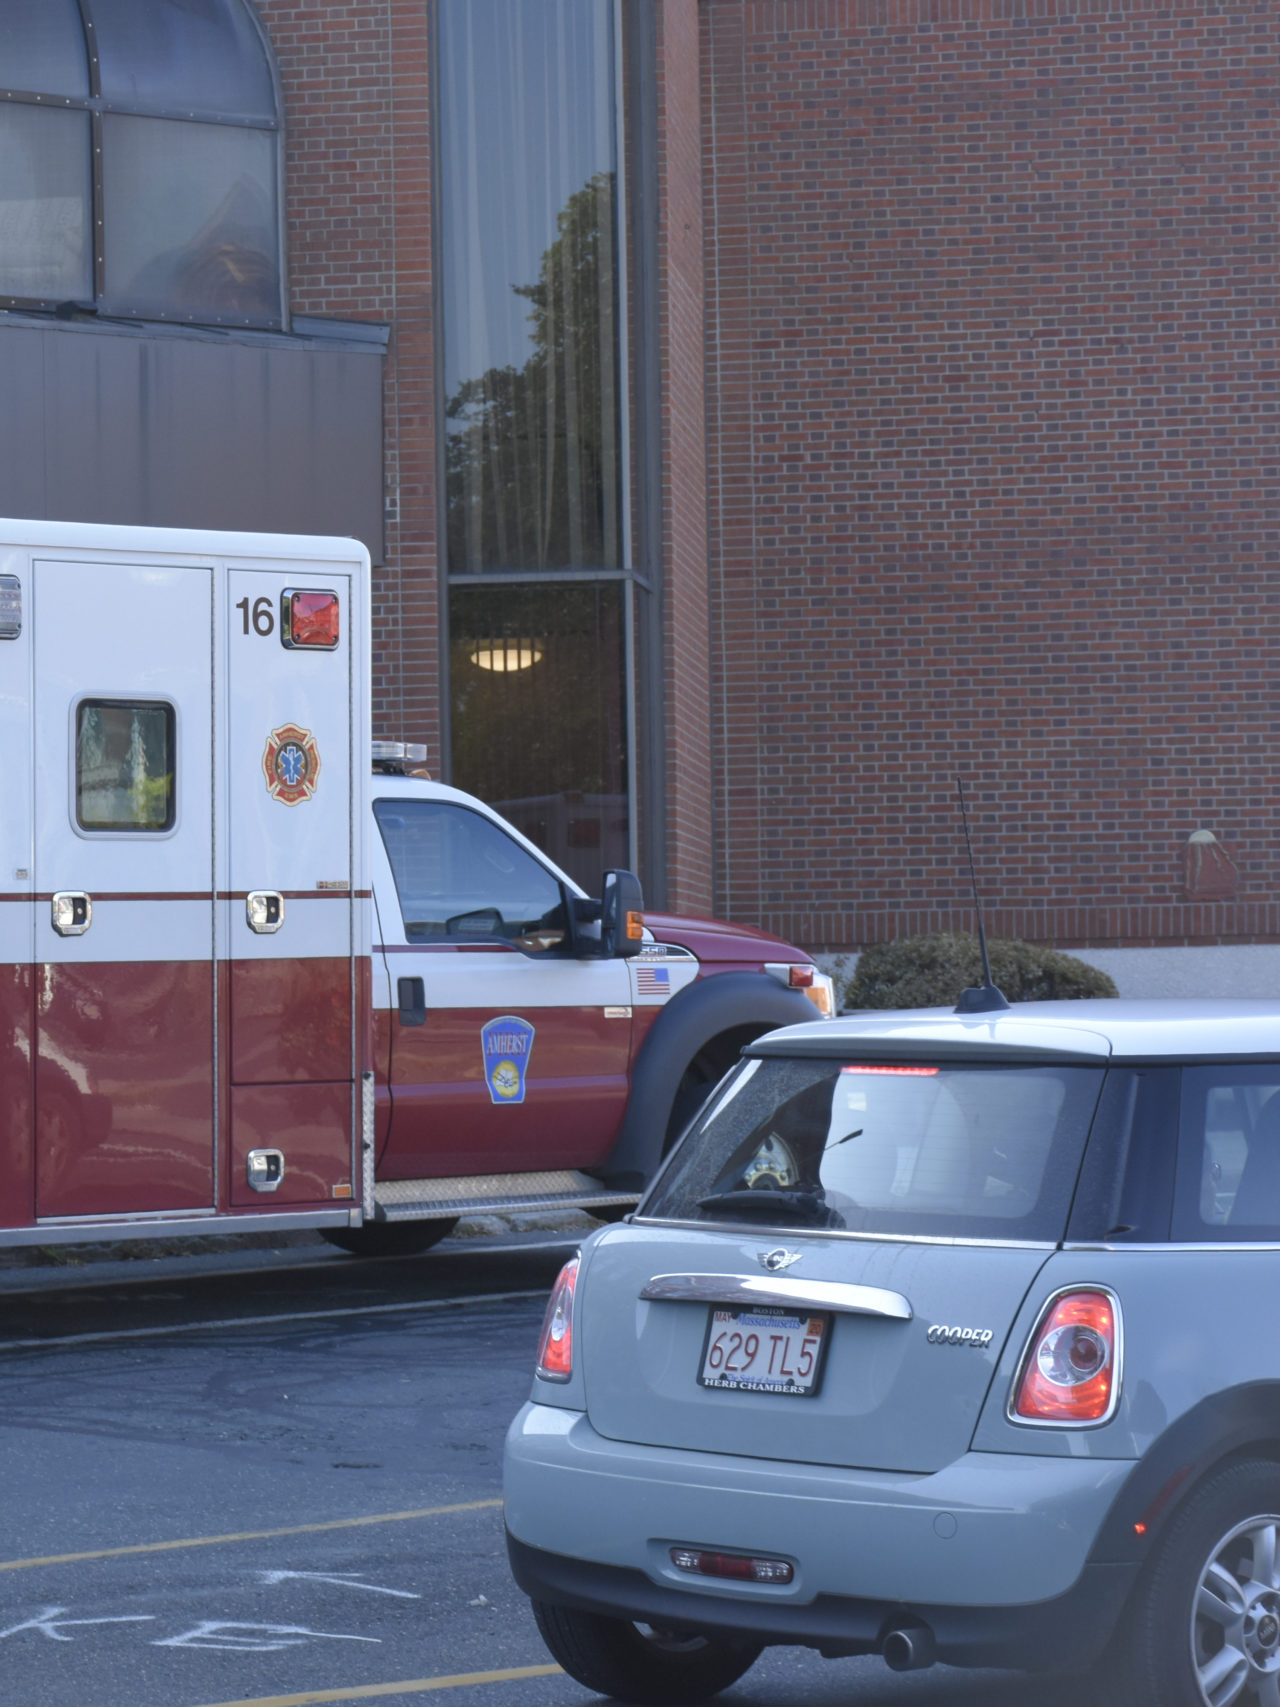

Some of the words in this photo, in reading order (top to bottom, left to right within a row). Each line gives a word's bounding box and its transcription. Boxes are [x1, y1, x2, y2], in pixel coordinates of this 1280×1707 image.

[235, 596, 275, 637] 16
[486, 1031, 529, 1056] AMHERST
[714, 1311, 733, 1322] MAY
[736, 1312, 801, 1330] Massachusetts
[927, 1324, 993, 1348] COOPER
[709, 1331, 760, 1373] 629
[768, 1334, 817, 1378] TL5
[704, 1378, 737, 1389] HERB
[739, 1381, 805, 1394] CHAMBERS
